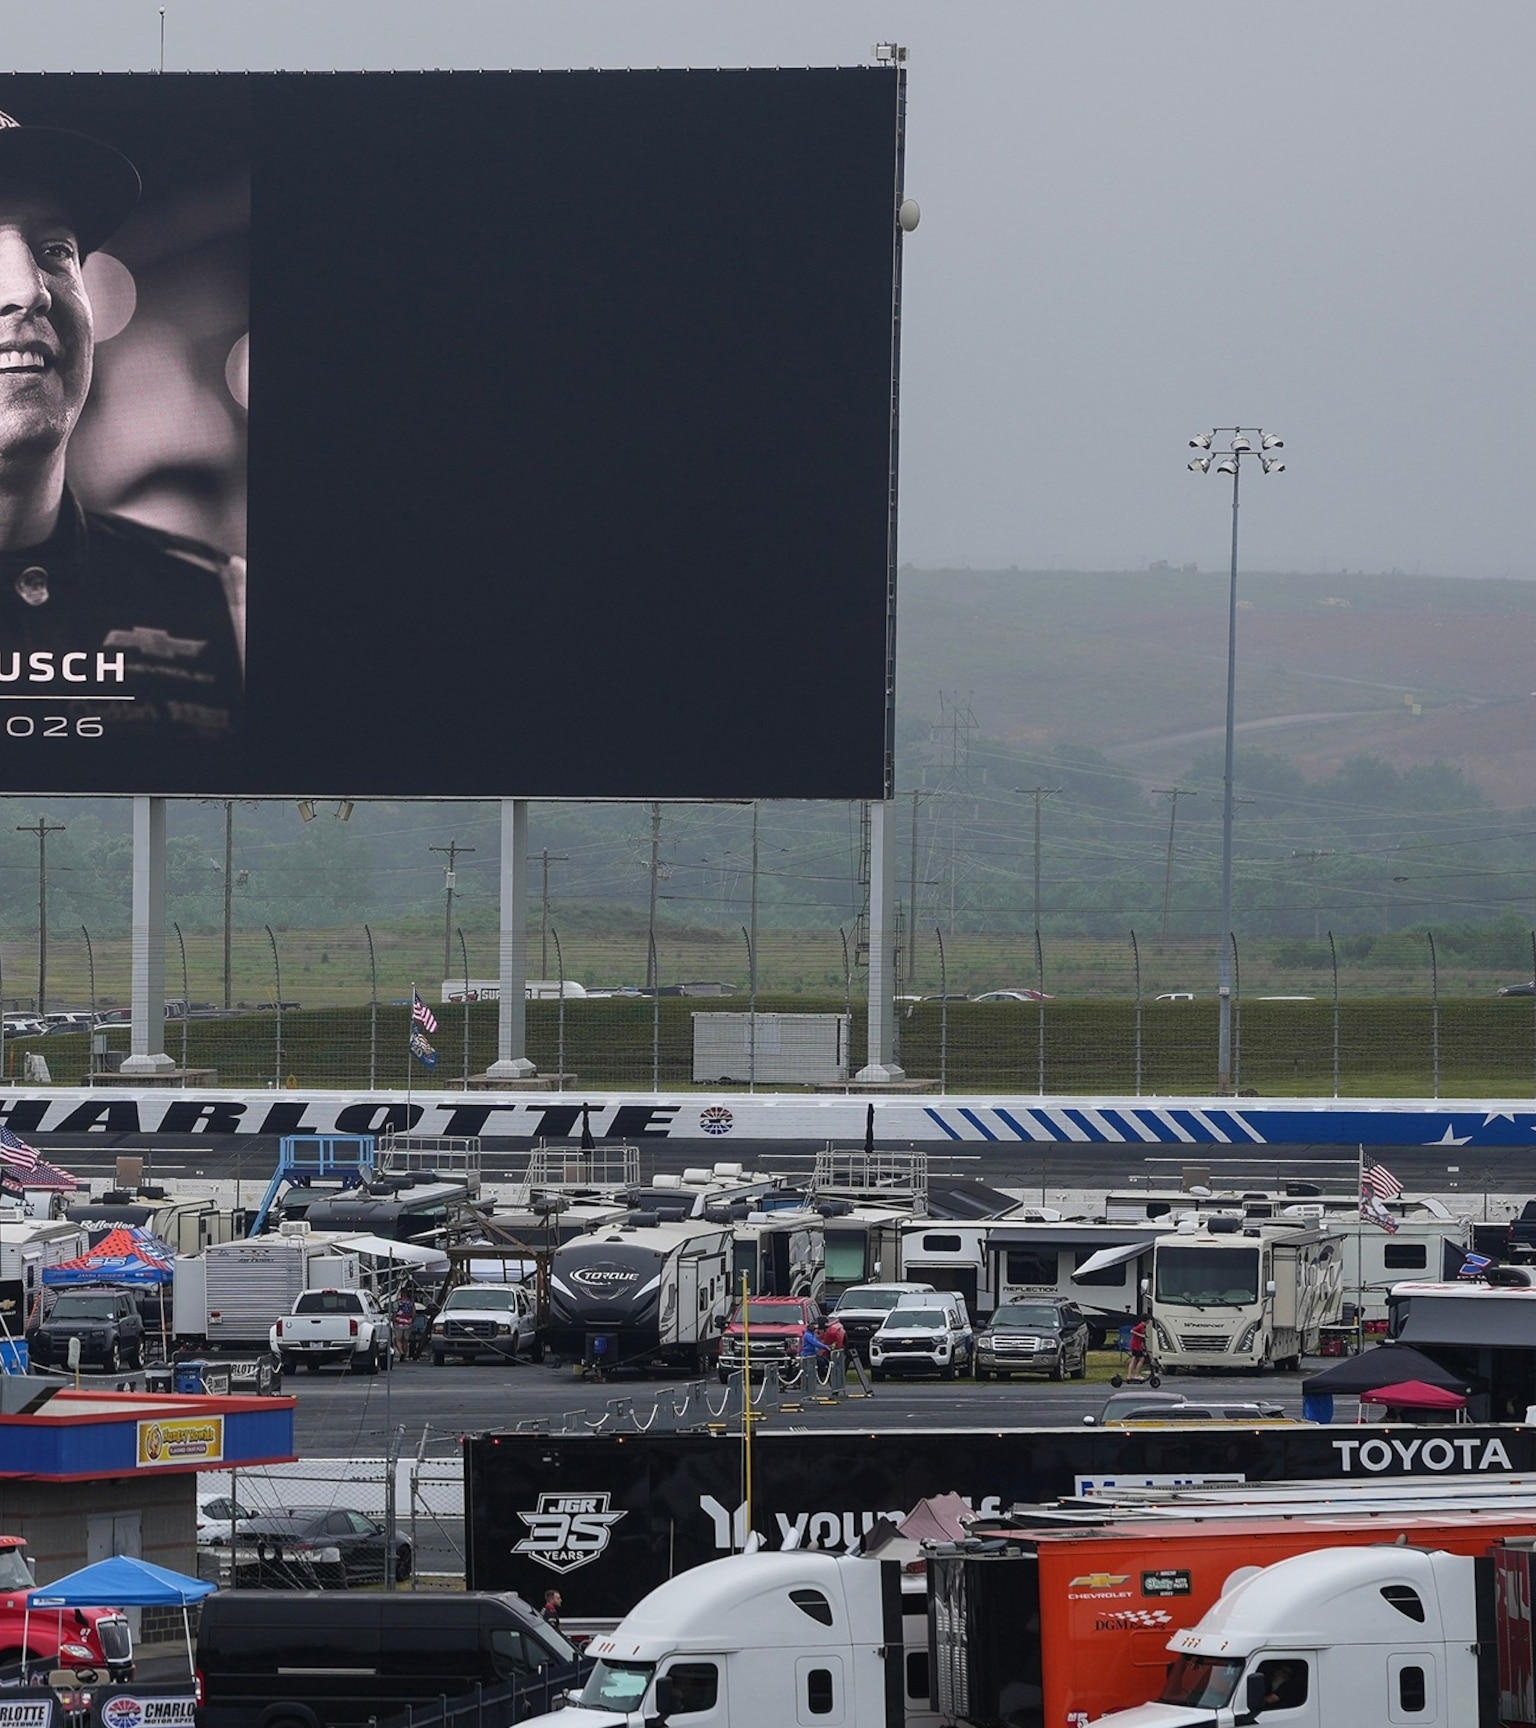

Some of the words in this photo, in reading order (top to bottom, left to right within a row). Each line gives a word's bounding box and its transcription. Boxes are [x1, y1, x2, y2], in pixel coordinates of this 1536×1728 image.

[79, 1220, 136, 1231] Reflection
[584, 1272, 640, 1281] TORQUE
[1332, 1438, 1513, 1471] TOYOTA
[548, 1499, 597, 1513] JGR
[516, 1513, 620, 1550] 35
[543, 1551, 584, 1560] YEARS
[1068, 1592, 1133, 1600] CHEVROLET
[1095, 1620, 1128, 1631] DGM
[145, 1702, 195, 1718] CHARLO
